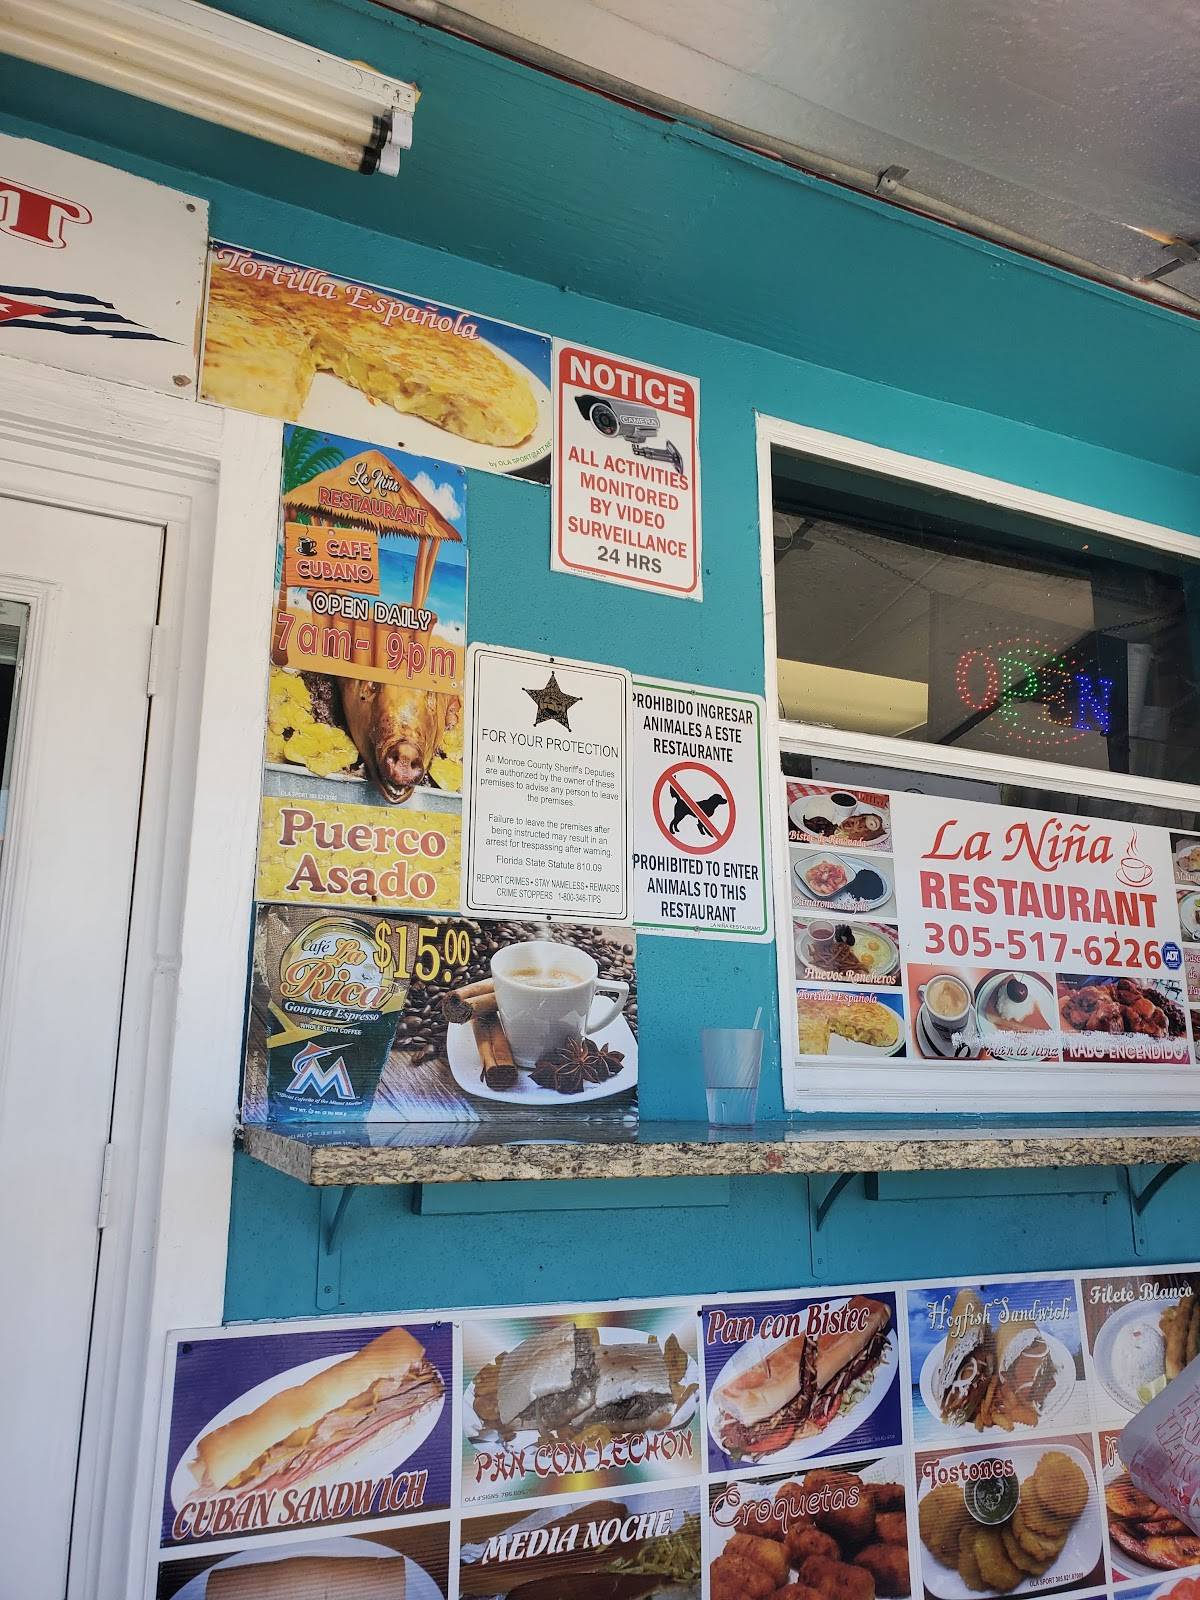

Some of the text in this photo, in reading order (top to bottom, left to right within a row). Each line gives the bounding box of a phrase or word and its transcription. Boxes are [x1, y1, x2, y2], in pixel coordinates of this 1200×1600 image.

[217, 247, 479, 341] Tortilla Española
[570, 355, 686, 413] NOTICE
[349, 461, 401, 497] La Niña
[568, 446, 689, 491] ALL ACTIVITIES
[580, 471, 679, 511] MONITORED
[318, 486, 429, 527] RESTAURANT
[590, 496, 665, 530] BY VIDEO
[326, 539, 372, 561] CAFE
[568, 516, 687, 559] SURVEILLANCE
[296, 560, 373, 583] CUBANO
[597, 545, 621, 564] 24
[626, 551, 662, 574] HRS
[313, 591, 433, 631] OPEN DAILY
[385, 631, 457, 679] 9pm
[955, 650, 1113, 733] OPEN
[696, 702, 753, 725] INGRESAR
[481, 728, 619, 758] FOR YOUR PROTECTION
[643, 715, 742, 744] ANIMALES A ESTE
[653, 737, 733, 763] RESTAURANTE
[485, 767, 615, 789] are authorized by the owner of these
[486, 754, 615, 779] All Monroe County Sheriff's Deputies
[480, 777, 619, 801] premises to advise any person to leave
[527, 793, 538, 802] the
[278, 808, 447, 859] Puerco
[488, 813, 611, 834] Failure to leave the premises after
[491, 826, 608, 845] being instructed may result in an
[485, 838, 508, 847] arrest
[509, 839, 520, 848] for
[521, 841, 564, 853] trespassing
[565, 844, 582, 854] after
[920, 818, 1114, 872] La Niña
[285, 853, 438, 900] Asado
[496, 855, 603, 873] Florida State Statute 810.09
[633, 853, 759, 881] PROHIBITED TO ENTER
[476, 873, 620, 893] REPORT CRIMES STAY NAMELESS REWARDS
[496, 887, 518, 898] CRIME
[519, 889, 553, 900] STOPPERS
[647, 877, 747, 901] ANIMALS TO THIS
[661, 901, 737, 922] RESTAURANT
[919, 870, 1158, 928] RESTAURANT
[301, 938, 367, 967] Café La
[373, 919, 471, 983] $15.00
[923, 922, 1162, 970] 305-517-6226
[1166, 952, 1179, 961] ADT
[280, 958, 393, 1010] Rica
[804, 967, 897, 985] Huevos Rancheros
[798, 989, 878, 1005] Tortilla Española
[284, 1001, 379, 1024] Gourmet Espresso
[300, 1023, 321, 1031] WHOLE
[340, 1028, 362, 1036] COFFEE
[1109, 1045, 1184, 1060] ENCENDIDO
[1089, 1281, 1195, 1305] Filete Blanco
[706, 1303, 871, 1346] Pan con Bistec
[927, 1294, 1072, 1337] Hogfish Sandwich
[474, 1429, 694, 1484] PAN CON LECHON
[920, 1456, 1015, 1490] Tostones
[172, 1469, 429, 1541] CUBAN SANDWICH
[710, 1482, 860, 1534] Croquetas
[481, 1508, 674, 1565] MEDIA NOCHE
